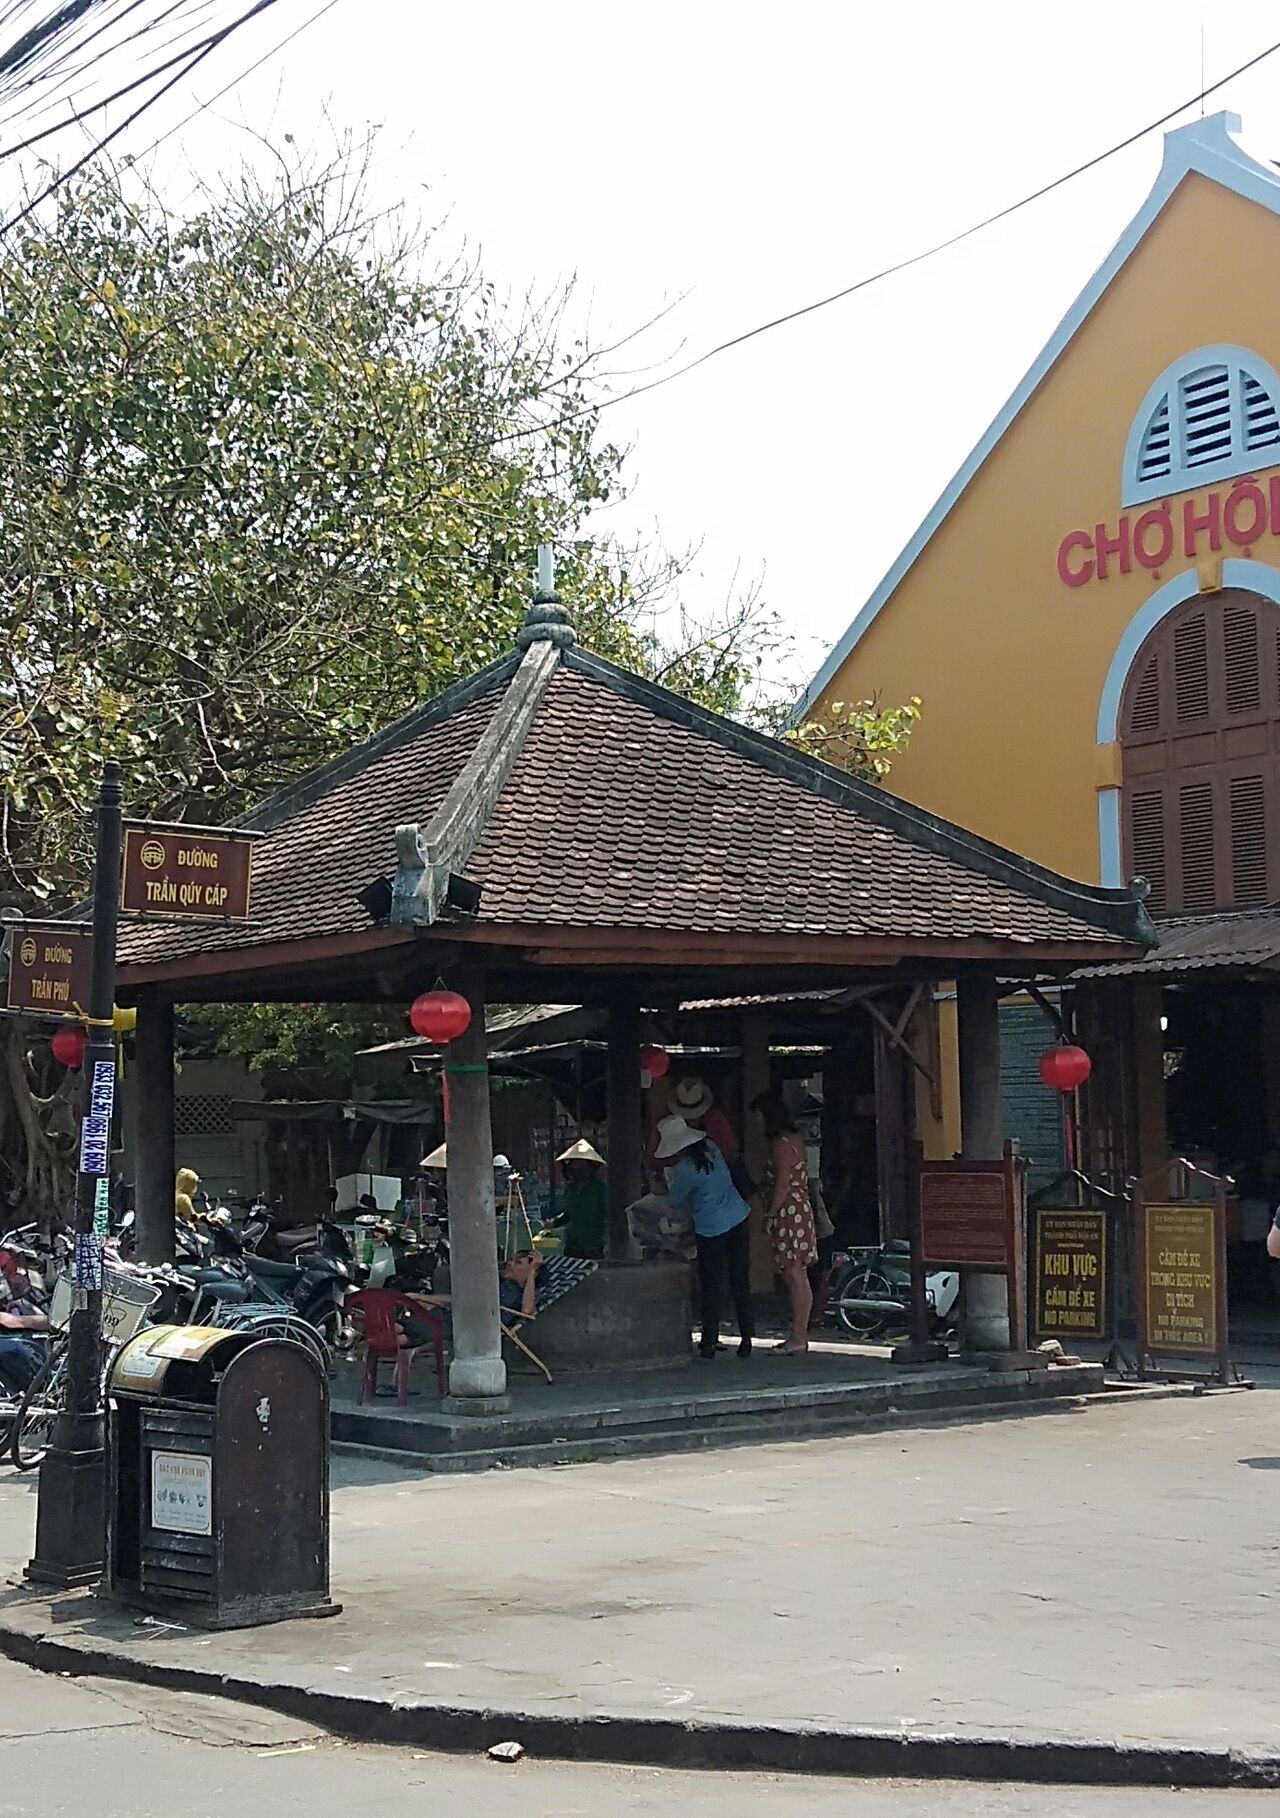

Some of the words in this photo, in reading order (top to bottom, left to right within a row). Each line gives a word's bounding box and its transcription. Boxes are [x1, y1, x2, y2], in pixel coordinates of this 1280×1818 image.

[1056, 499, 1174, 588] CHỢ
[177, 846, 218, 868] ĐƯỜNG
[146, 875, 176, 902] TRẦN
[1044, 1253, 1069, 1276] KHU
[1083, 1291, 1095, 1307] XE
[1045, 1310, 1057, 1325] NO
[1058, 1311, 1096, 1327] PARKING
